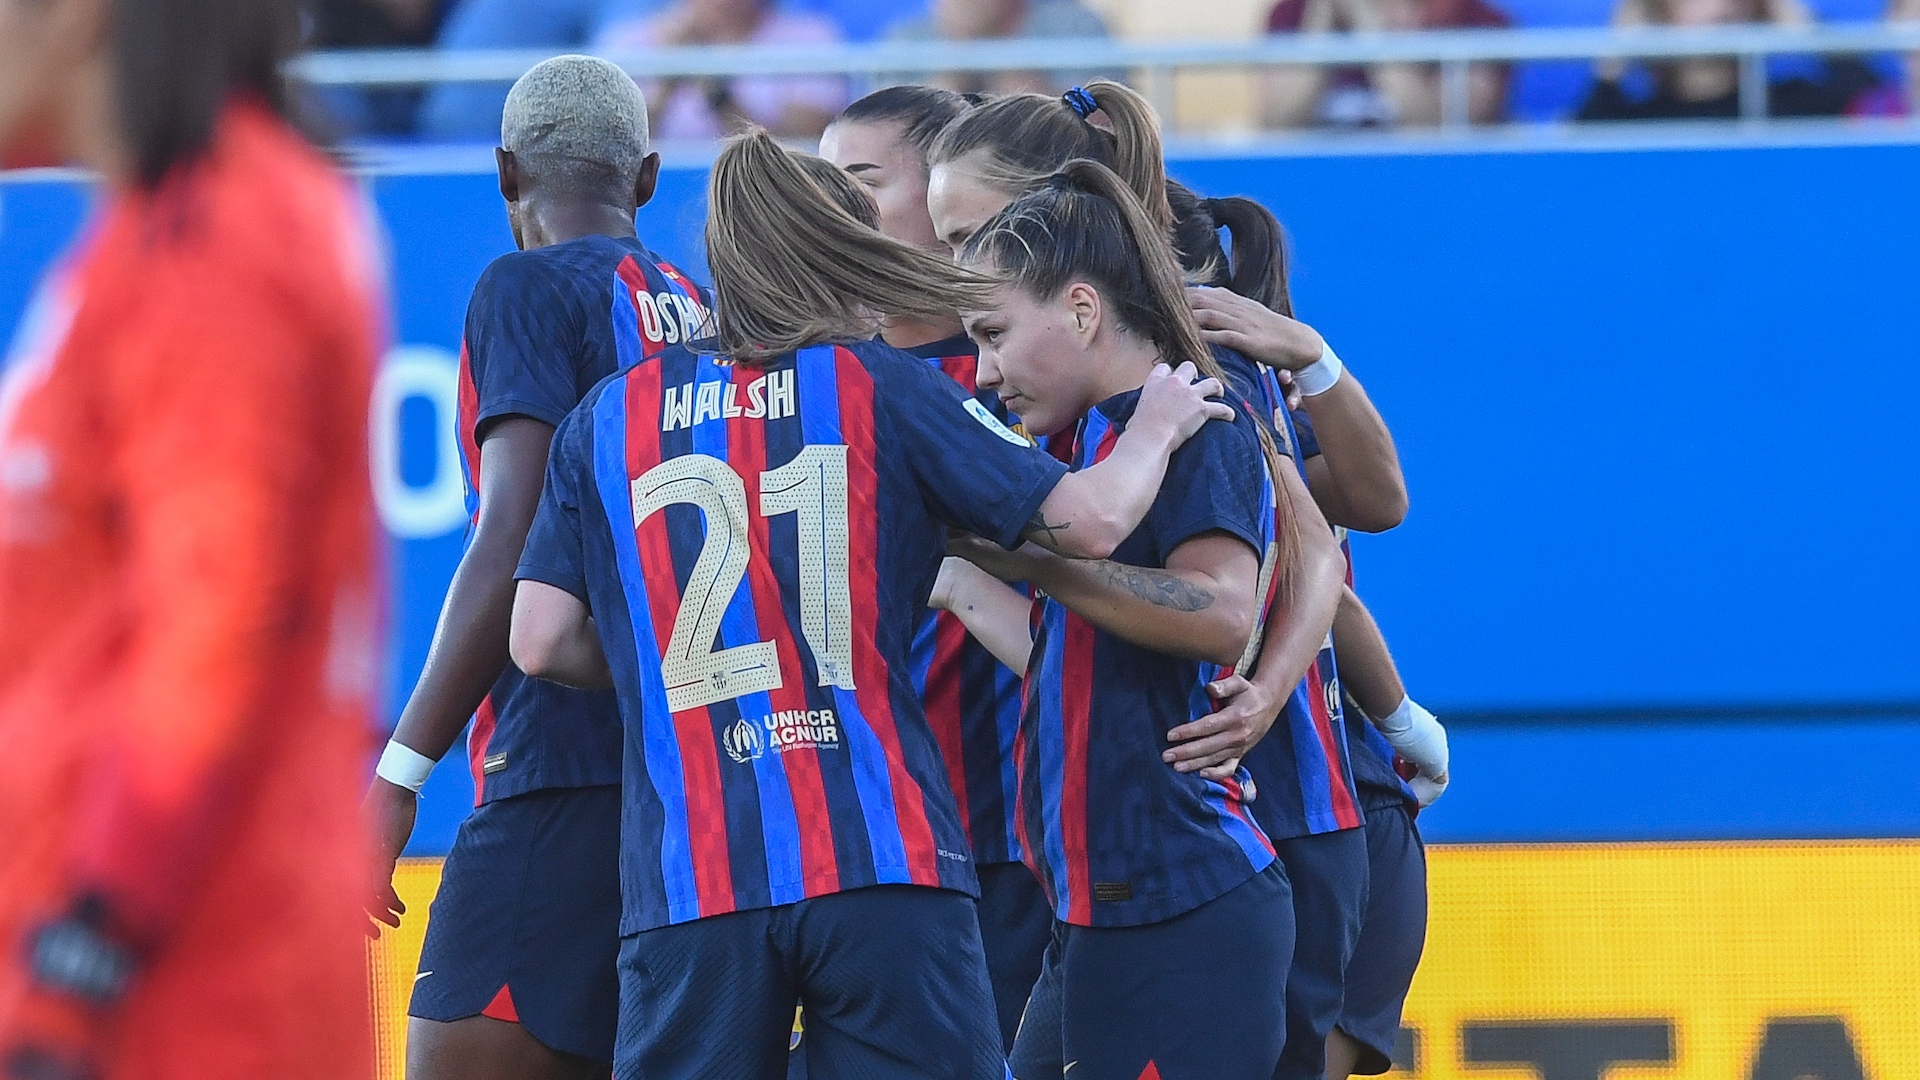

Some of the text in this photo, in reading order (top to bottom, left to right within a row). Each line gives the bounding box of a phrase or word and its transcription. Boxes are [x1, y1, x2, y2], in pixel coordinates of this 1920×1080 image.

[662, 368, 796, 432] WALSH
[631, 444, 857, 714] 21
[764, 709, 835, 730] UNHCR
[770, 726, 838, 747] ACNUR
